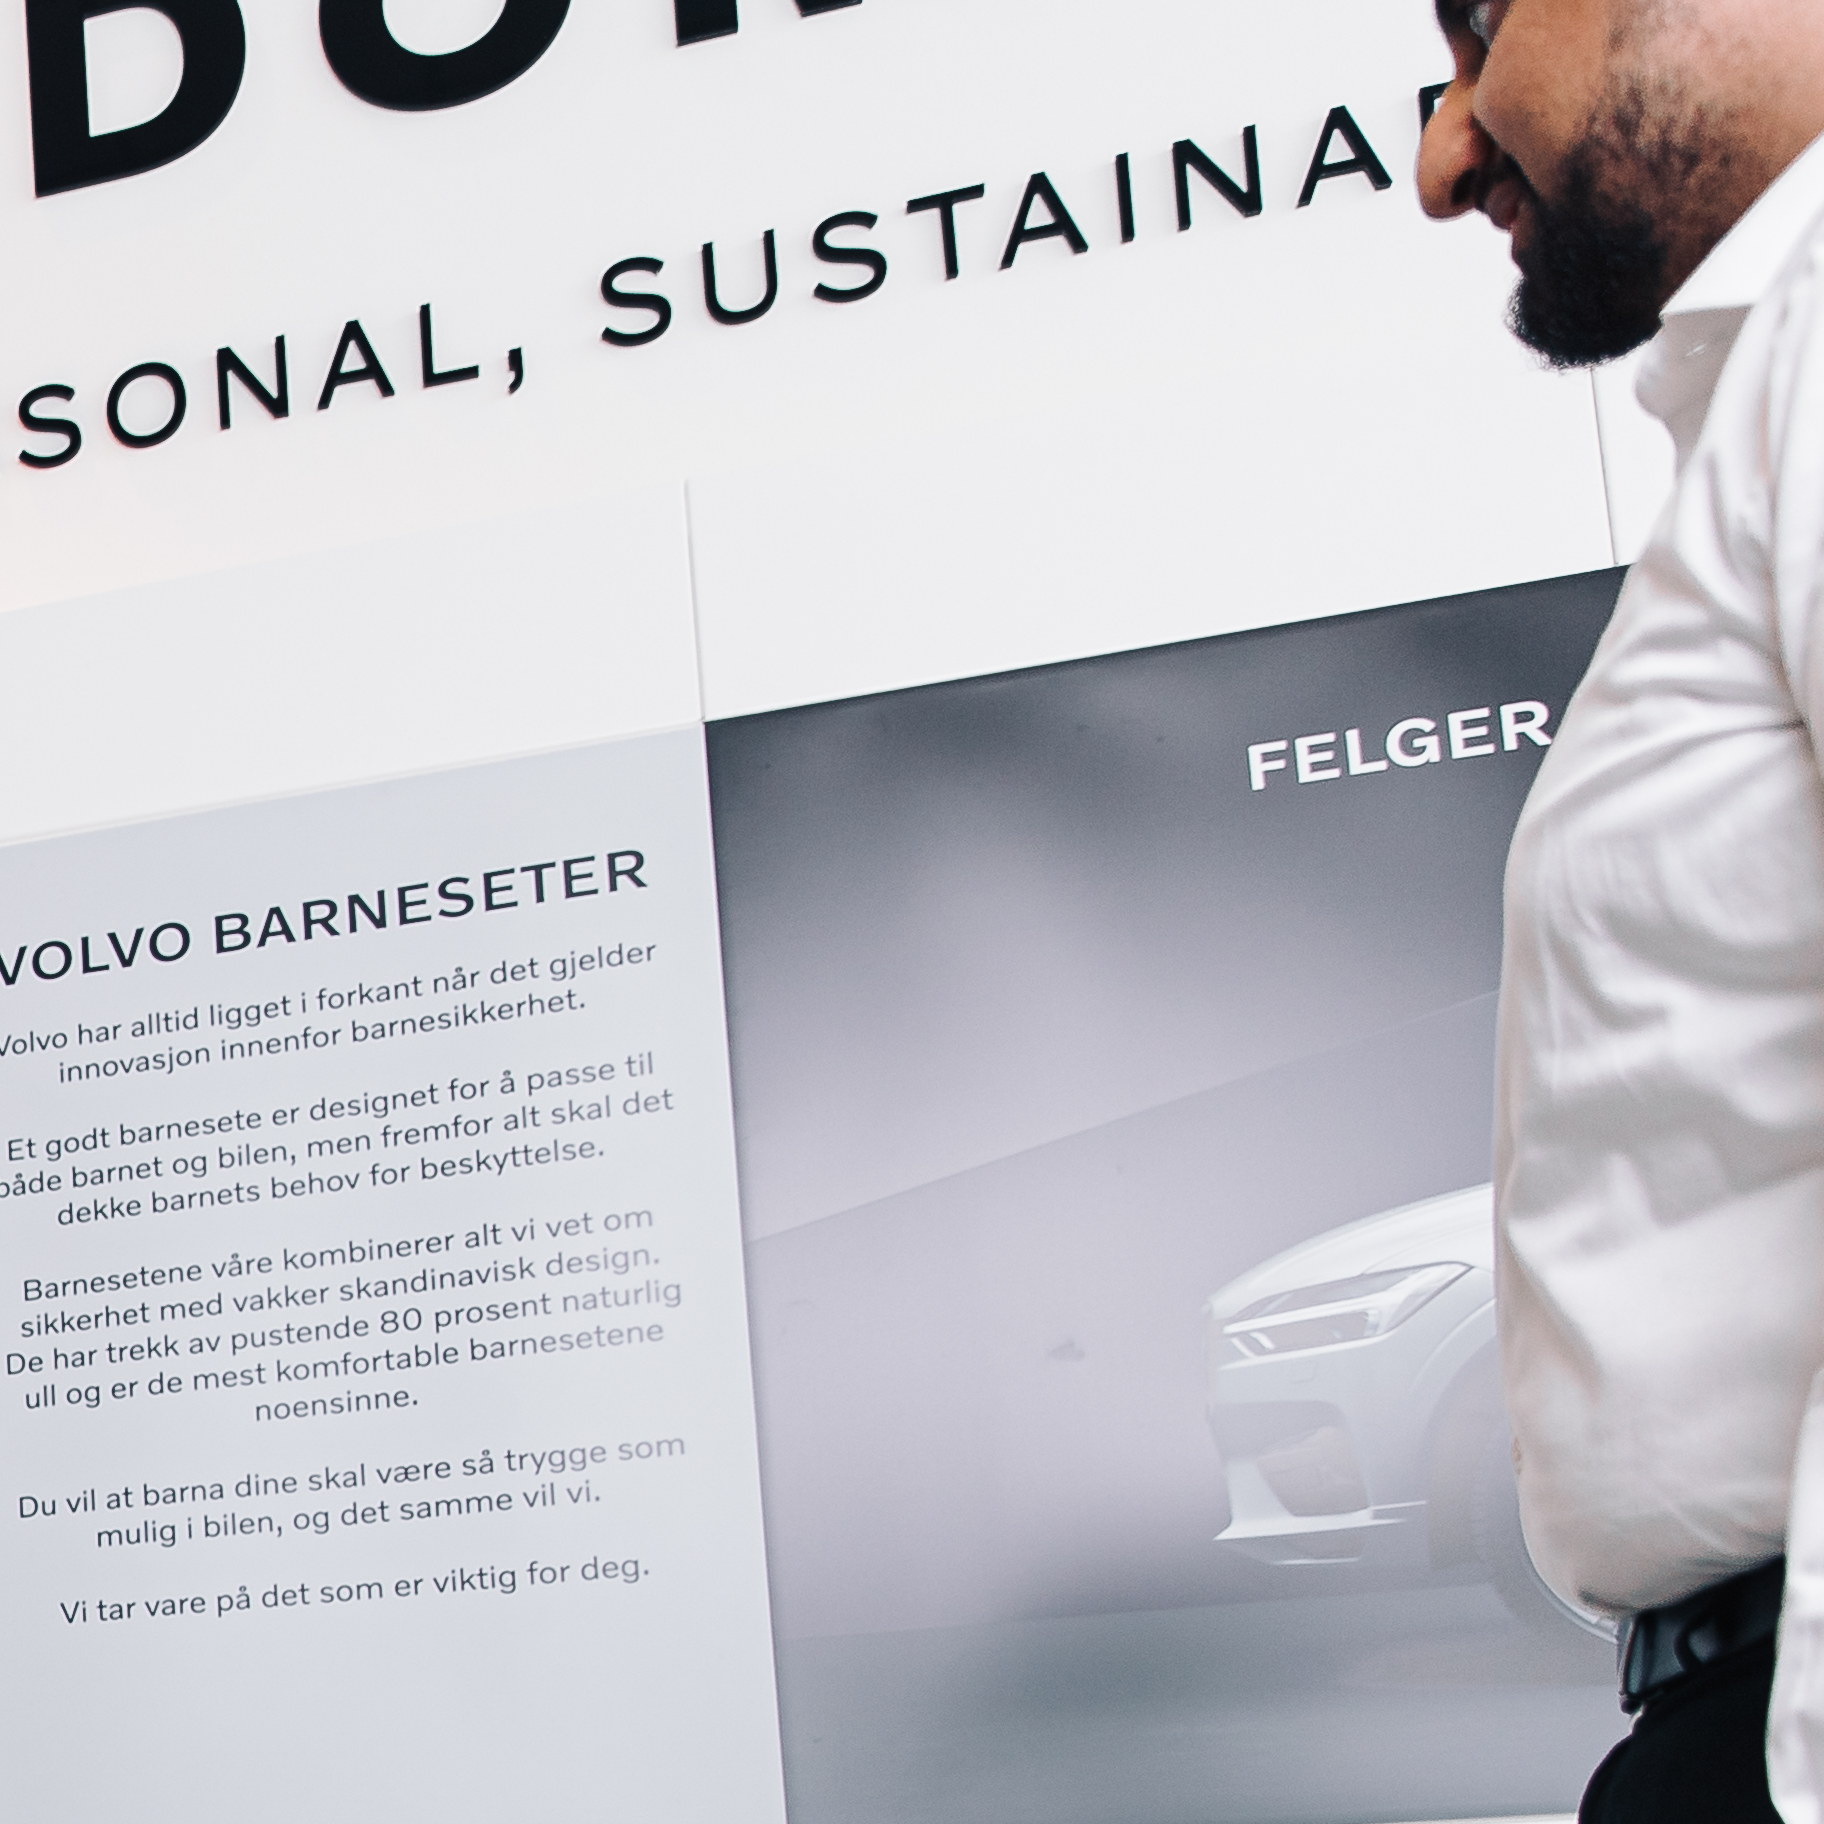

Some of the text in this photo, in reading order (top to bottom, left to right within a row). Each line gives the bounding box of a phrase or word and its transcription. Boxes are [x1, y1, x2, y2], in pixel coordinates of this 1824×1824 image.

[1247, 700, 1552, 791] FELGER
[213, 849, 649, 955] BARNESETER
[58, 988, 586, 1085] innovasjon innenfor barnesikkerhet.
[76, 1022, 123, 1047] har
[130, 1005, 200, 1039] alltid
[208, 994, 292, 1031] ligget
[301, 992, 307, 1014] i
[315, 974, 424, 1012] forkant
[432, 965, 481, 995] når
[489, 956, 540, 986] det
[548, 942, 657, 983] gjelder
[6, 1050, 654, 1163] Et godt barnesete er designet for å passe til
[70, 1155, 164, 1189] barnet
[171, 1154, 208, 1179] og
[217, 1142, 297, 1170] bilen,
[306, 1133, 372, 1159] men
[380, 1113, 494, 1149] fremfor
[502, 1104, 542, 1132] alt
[550, 1094, 612, 1126] skal
[621, 1087, 675, 1117] det
[56, 1138, 605, 1227] dekke barnets behov for beskyttelse.
[20, 1246, 661, 1339] sikkerhet med vakker skandinavisk design.
[22, 1209, 654, 1303] Barnesetene våre kombinerer alt vi vet om
[5, 1281, 683, 1377] De har trekk av pustende 80 prosent naturlig
[24, 1323, 665, 1411] ull og er de mest komfortable barnesetene
[254, 1389, 419, 1423] noensinne.
[18, 1437, 686, 1520] Du vil at barna dine skal være så trygge som
[96, 1478, 601, 1549] mulig i bilen, og det samme vil vi.
[58, 1554, 650, 1625] Vi tar vare på det som er viktig for deg.
